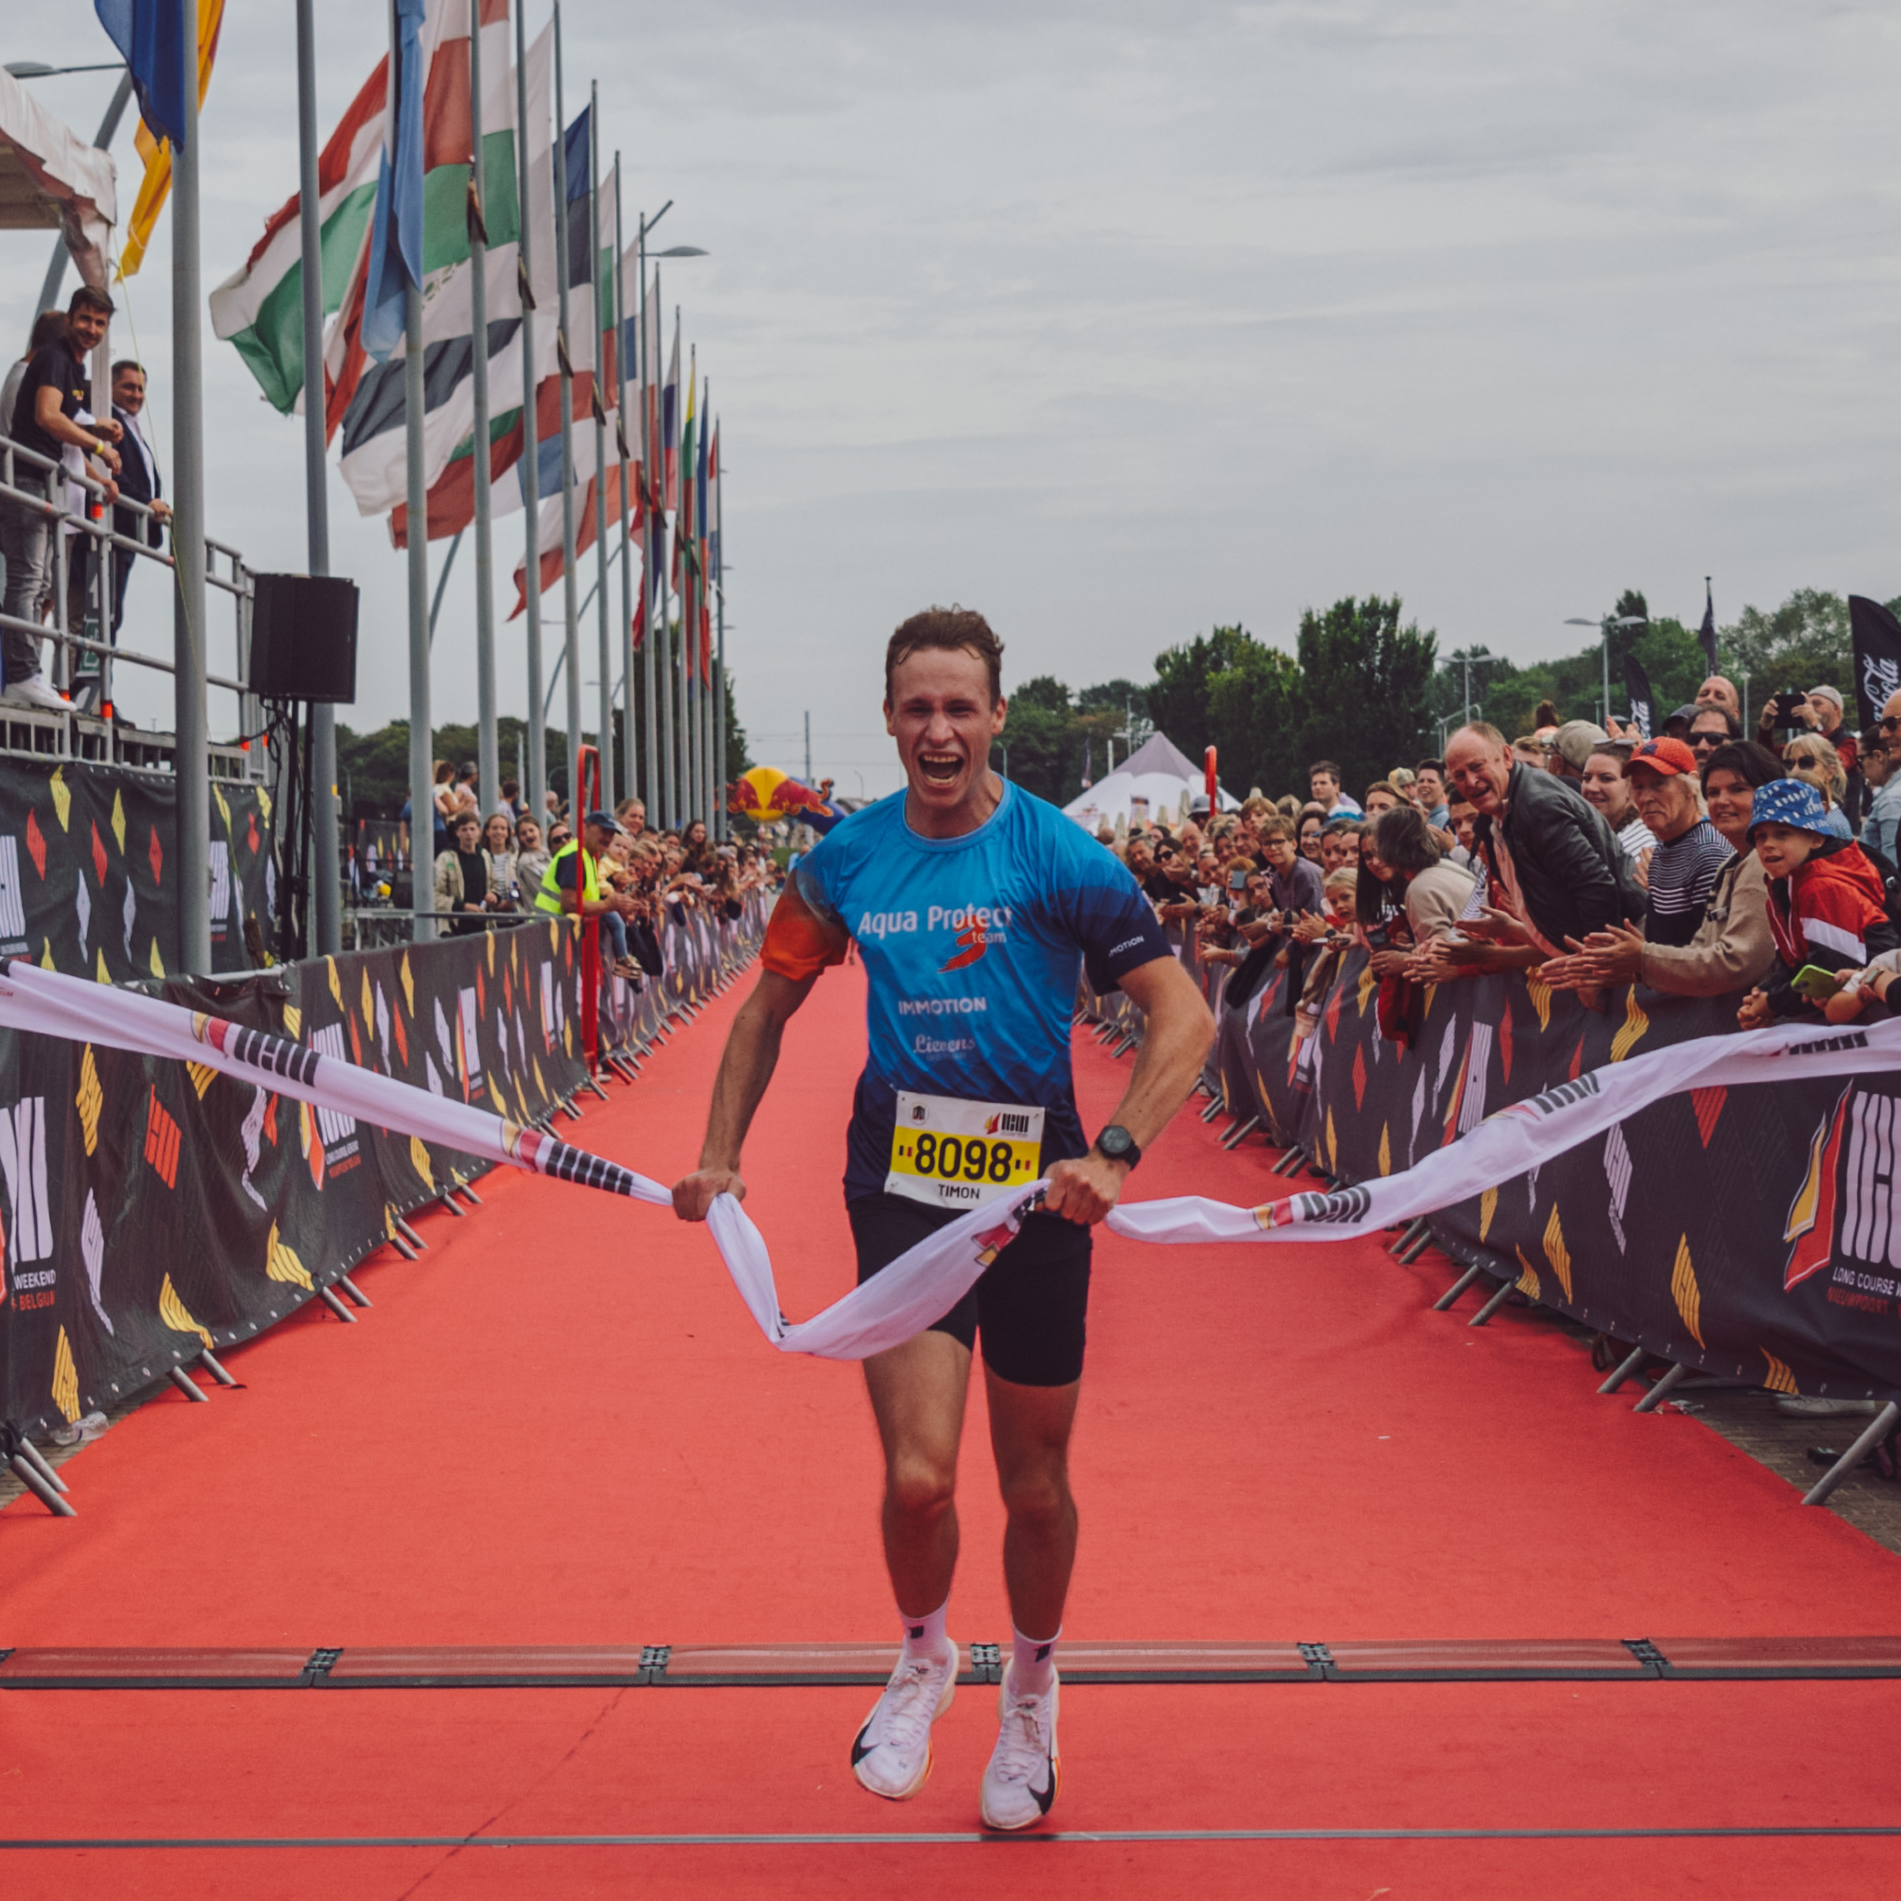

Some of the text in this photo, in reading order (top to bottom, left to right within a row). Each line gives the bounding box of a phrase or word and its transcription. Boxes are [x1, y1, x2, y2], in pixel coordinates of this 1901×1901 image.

[856, 903, 1012, 941] Aqua Protect
[972, 930, 1007, 944] team
[898, 997, 987, 1015] IMMOTION
[914, 1133, 1014, 1183] 8098
[938, 1184, 980, 1199] TIMON
[14, 1269, 56, 1290] WEEKEND
[1831, 1266, 1855, 1286] LONG
[1856, 1272, 1895, 1296] COURSE
[1827, 1286, 1889, 1317] NIEUWPOORT
